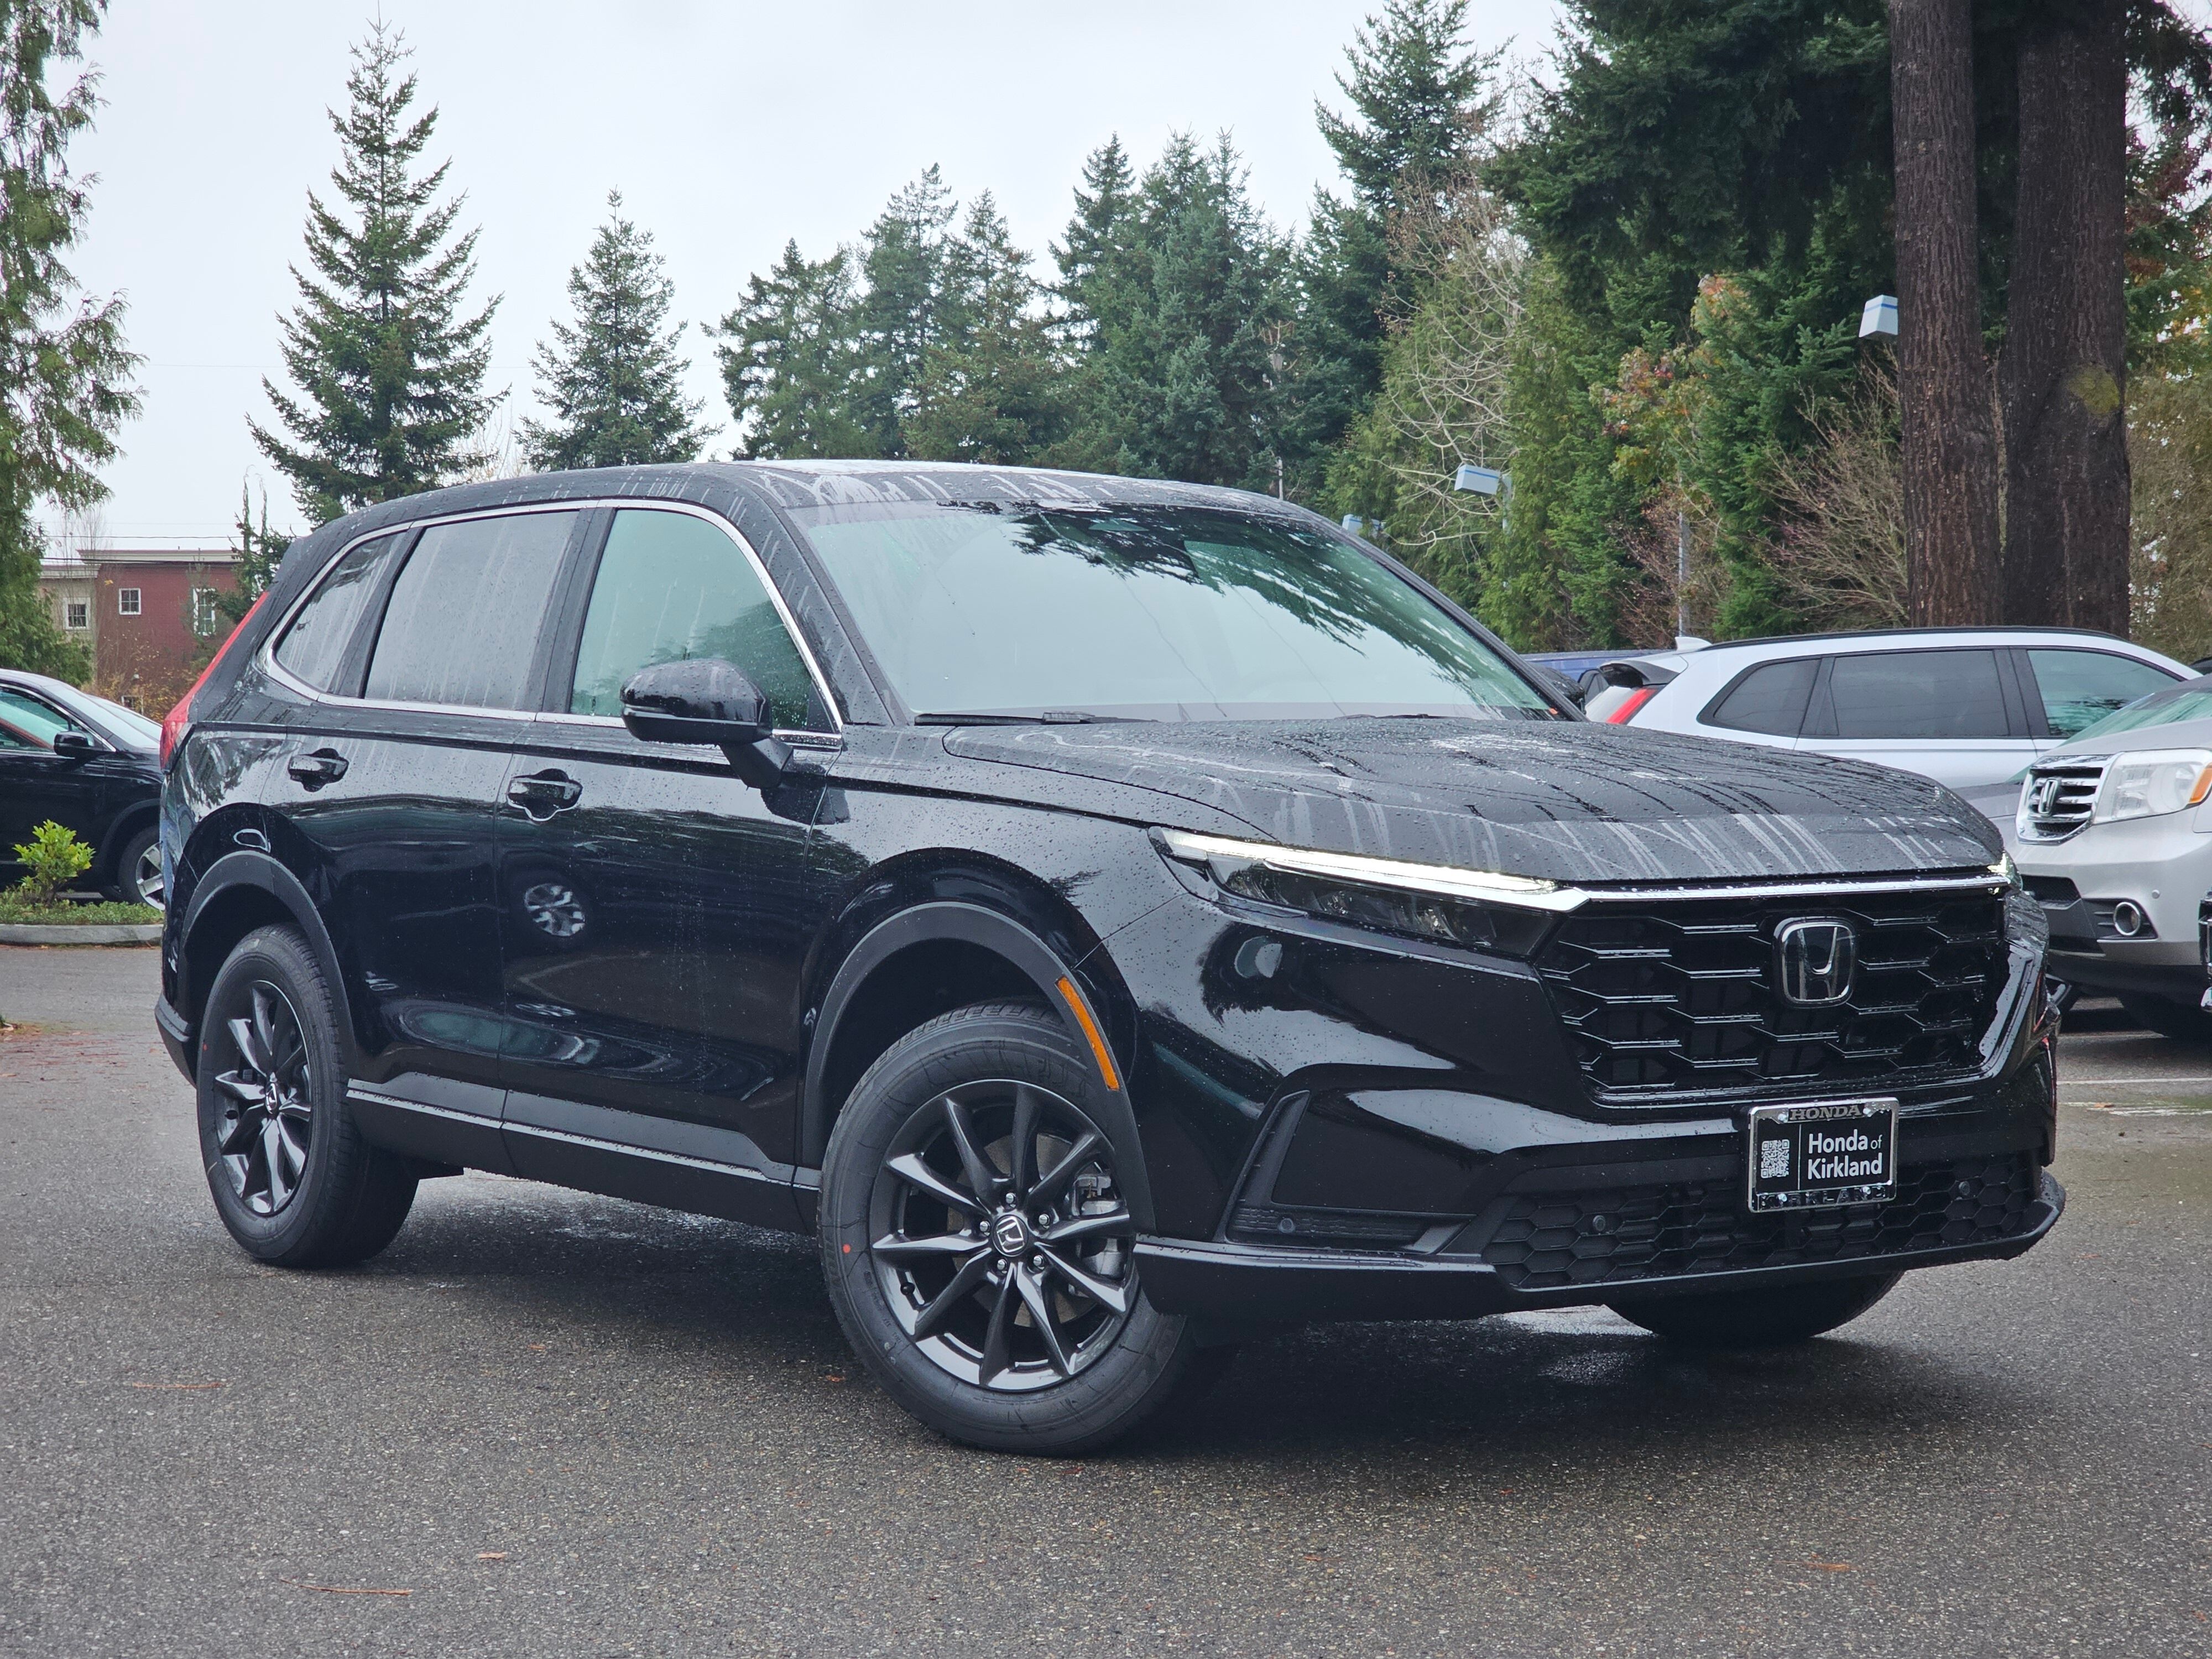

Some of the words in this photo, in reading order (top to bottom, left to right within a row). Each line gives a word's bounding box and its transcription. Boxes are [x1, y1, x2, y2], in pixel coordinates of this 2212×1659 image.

[1790, 1105, 1864, 1121] HONDA
[1808, 1129, 1868, 1154] Honda
[1870, 1135, 1883, 1150] of
[1808, 1152, 1883, 1180] Kirkland
[1760, 1185, 1886, 1209] KRKLAND
